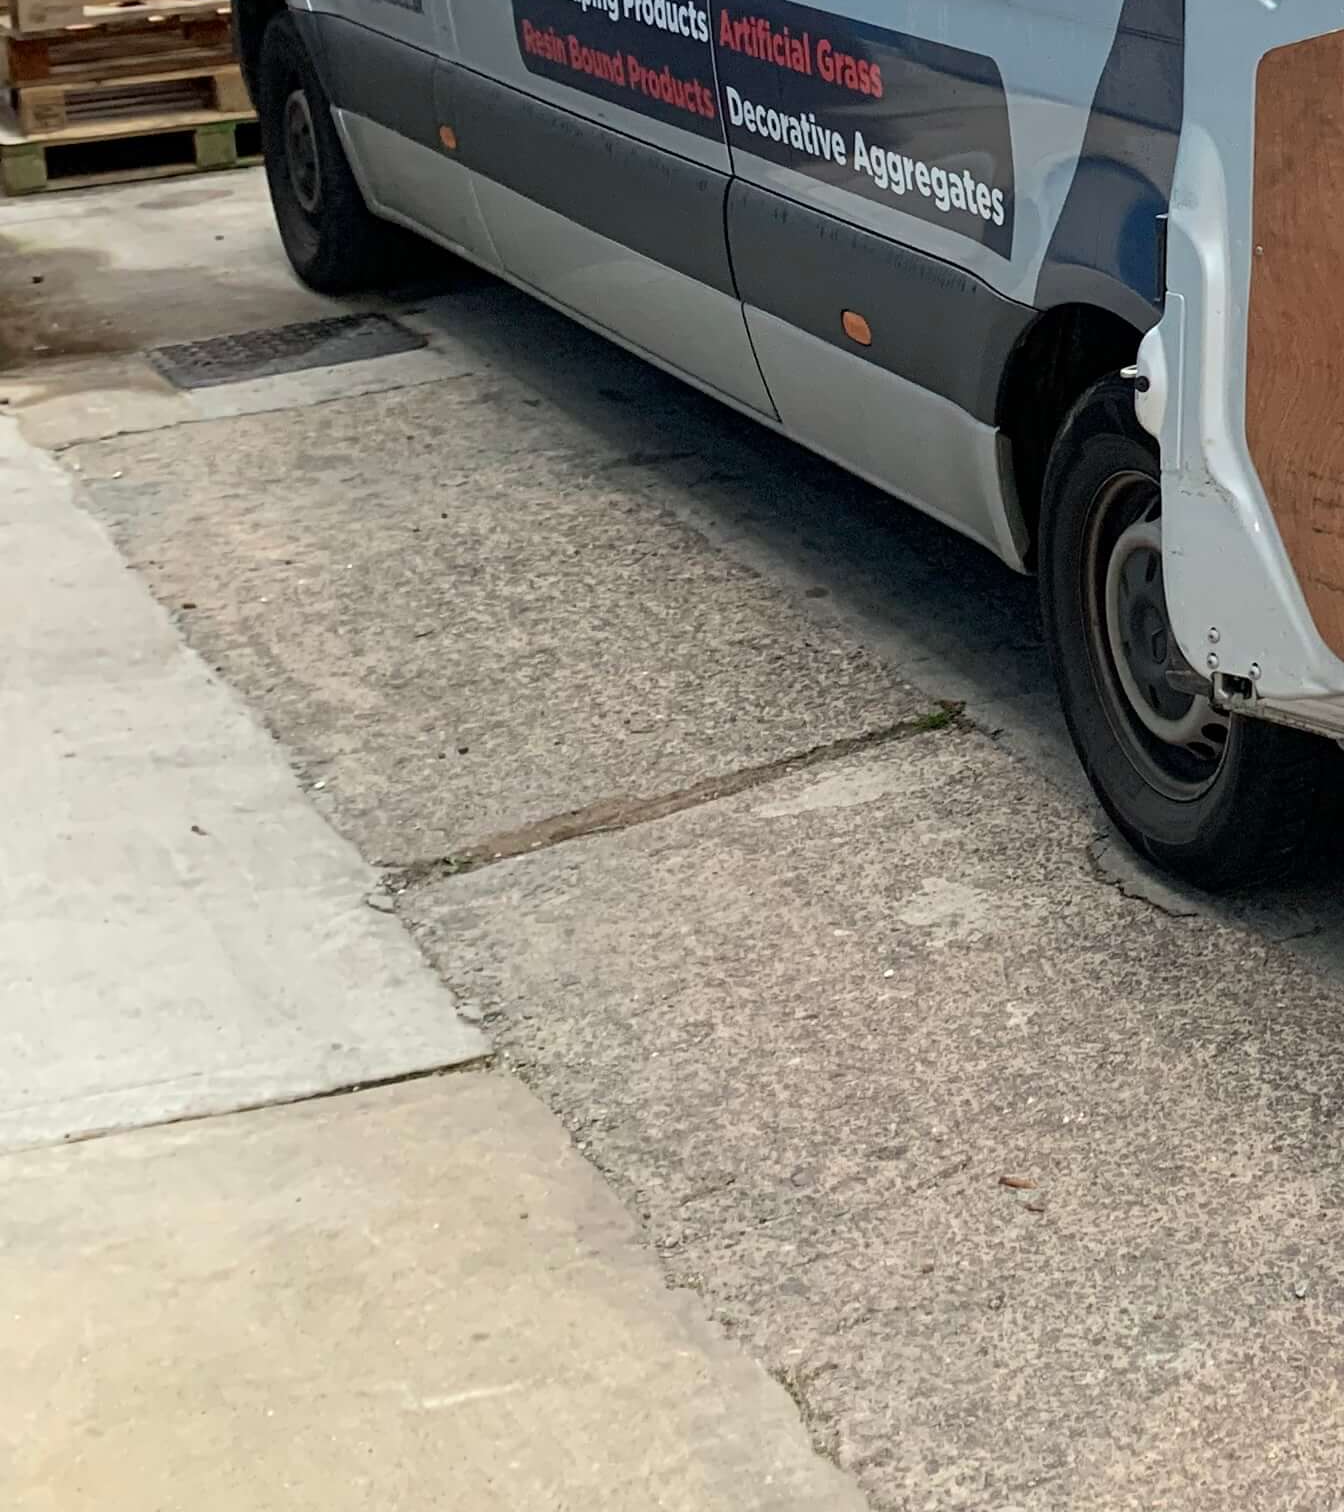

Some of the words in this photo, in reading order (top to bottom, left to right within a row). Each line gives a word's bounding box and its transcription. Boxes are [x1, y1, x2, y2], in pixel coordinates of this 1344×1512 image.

[521, 19, 568, 65] Resin
[568, 35, 626, 87] Bound
[626, 54, 716, 119] Products
[720, 8, 812, 75] Artificial
[816, 39, 884, 98] Grass
[726, 85, 847, 166] Decorative
[853, 131, 1005, 227] Aggregates
